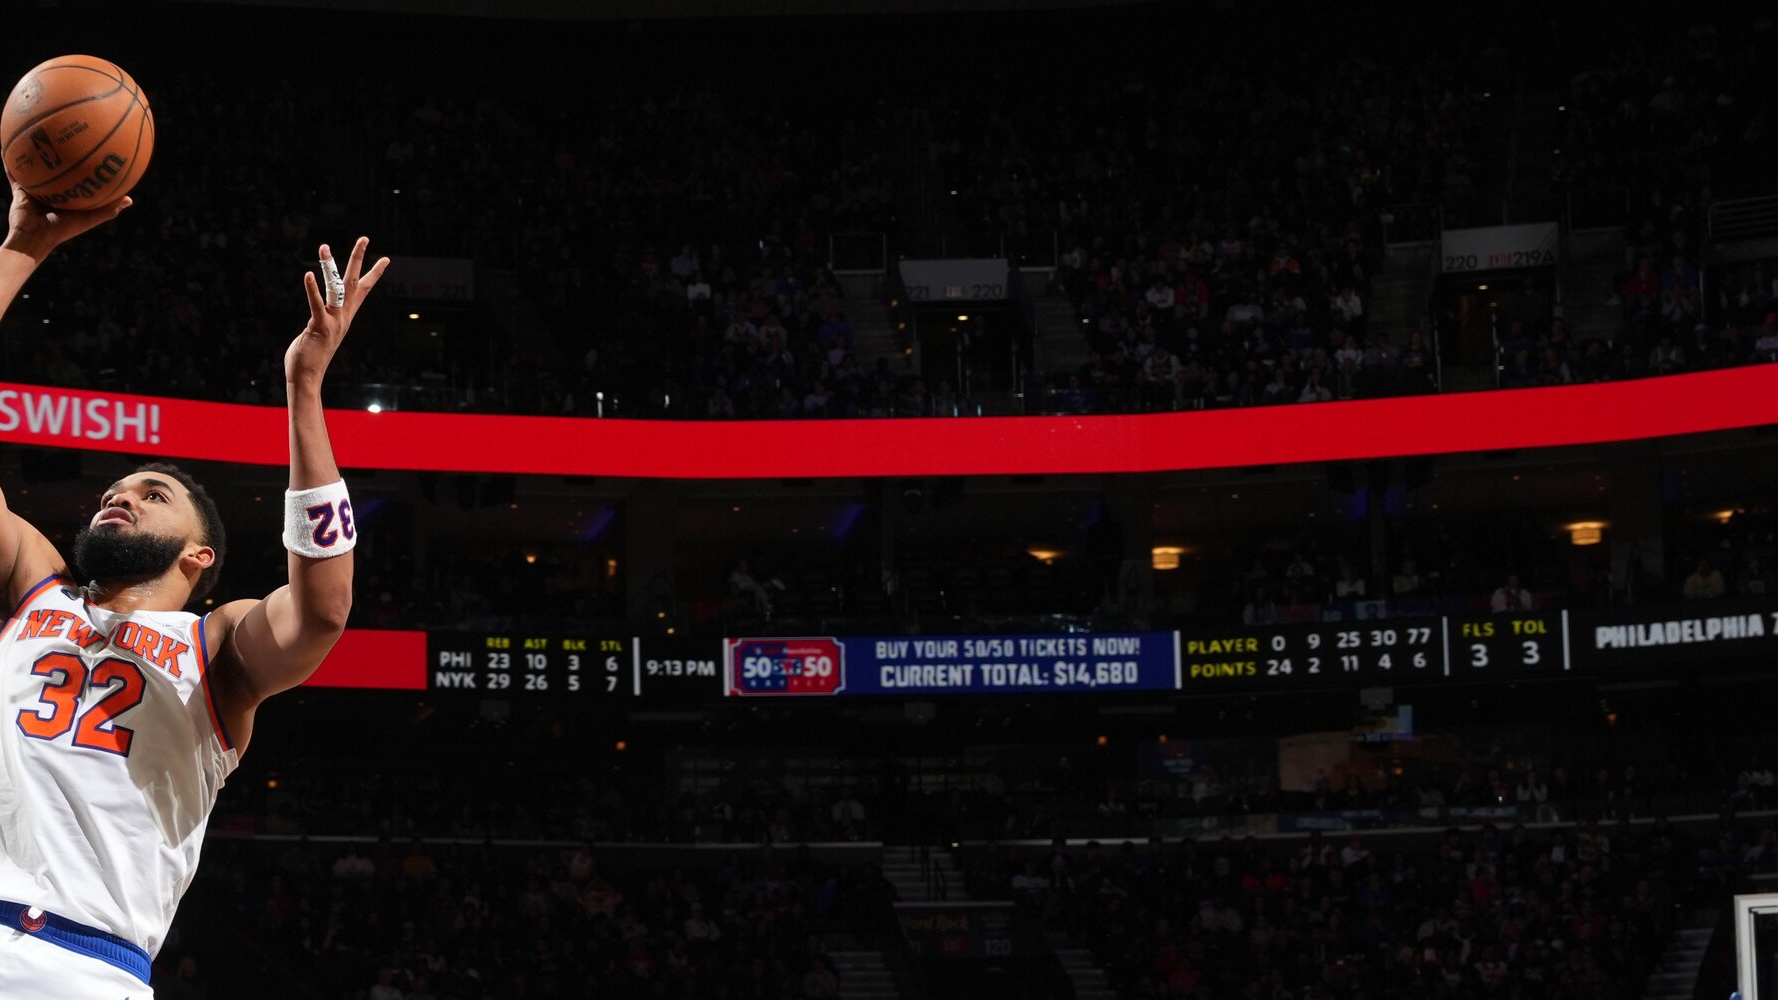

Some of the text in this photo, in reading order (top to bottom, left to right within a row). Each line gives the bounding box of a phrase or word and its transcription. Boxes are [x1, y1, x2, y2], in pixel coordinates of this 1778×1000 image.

[15, 608, 106, 649] NEW
[1462, 618, 1548, 638] FLS TOL
[1595, 614, 1765, 649] PHILADELPHIA
[486, 637, 623, 652] REB AST BLK STL
[875, 637, 1141, 659] BUY YOUR 50/50 TICKETS NOW!
[1187, 627, 1431, 655] PLAYER 0 9 25 30 77
[439, 651, 619, 672] PHI 23 10 3 6
[1190, 651, 1427, 679] POINTS 24 2 11 4 6
[1470, 640, 1541, 668] 3 3
[645, 660, 716, 677] 9:13 PM
[742, 656, 772, 679] 50
[803, 655, 832, 677] 50
[880, 661, 1139, 688] CURRENT TOTAL: $14,680
[435, 672, 619, 692] NYK 29 26 5 7
[15, 650, 147, 759] 32
